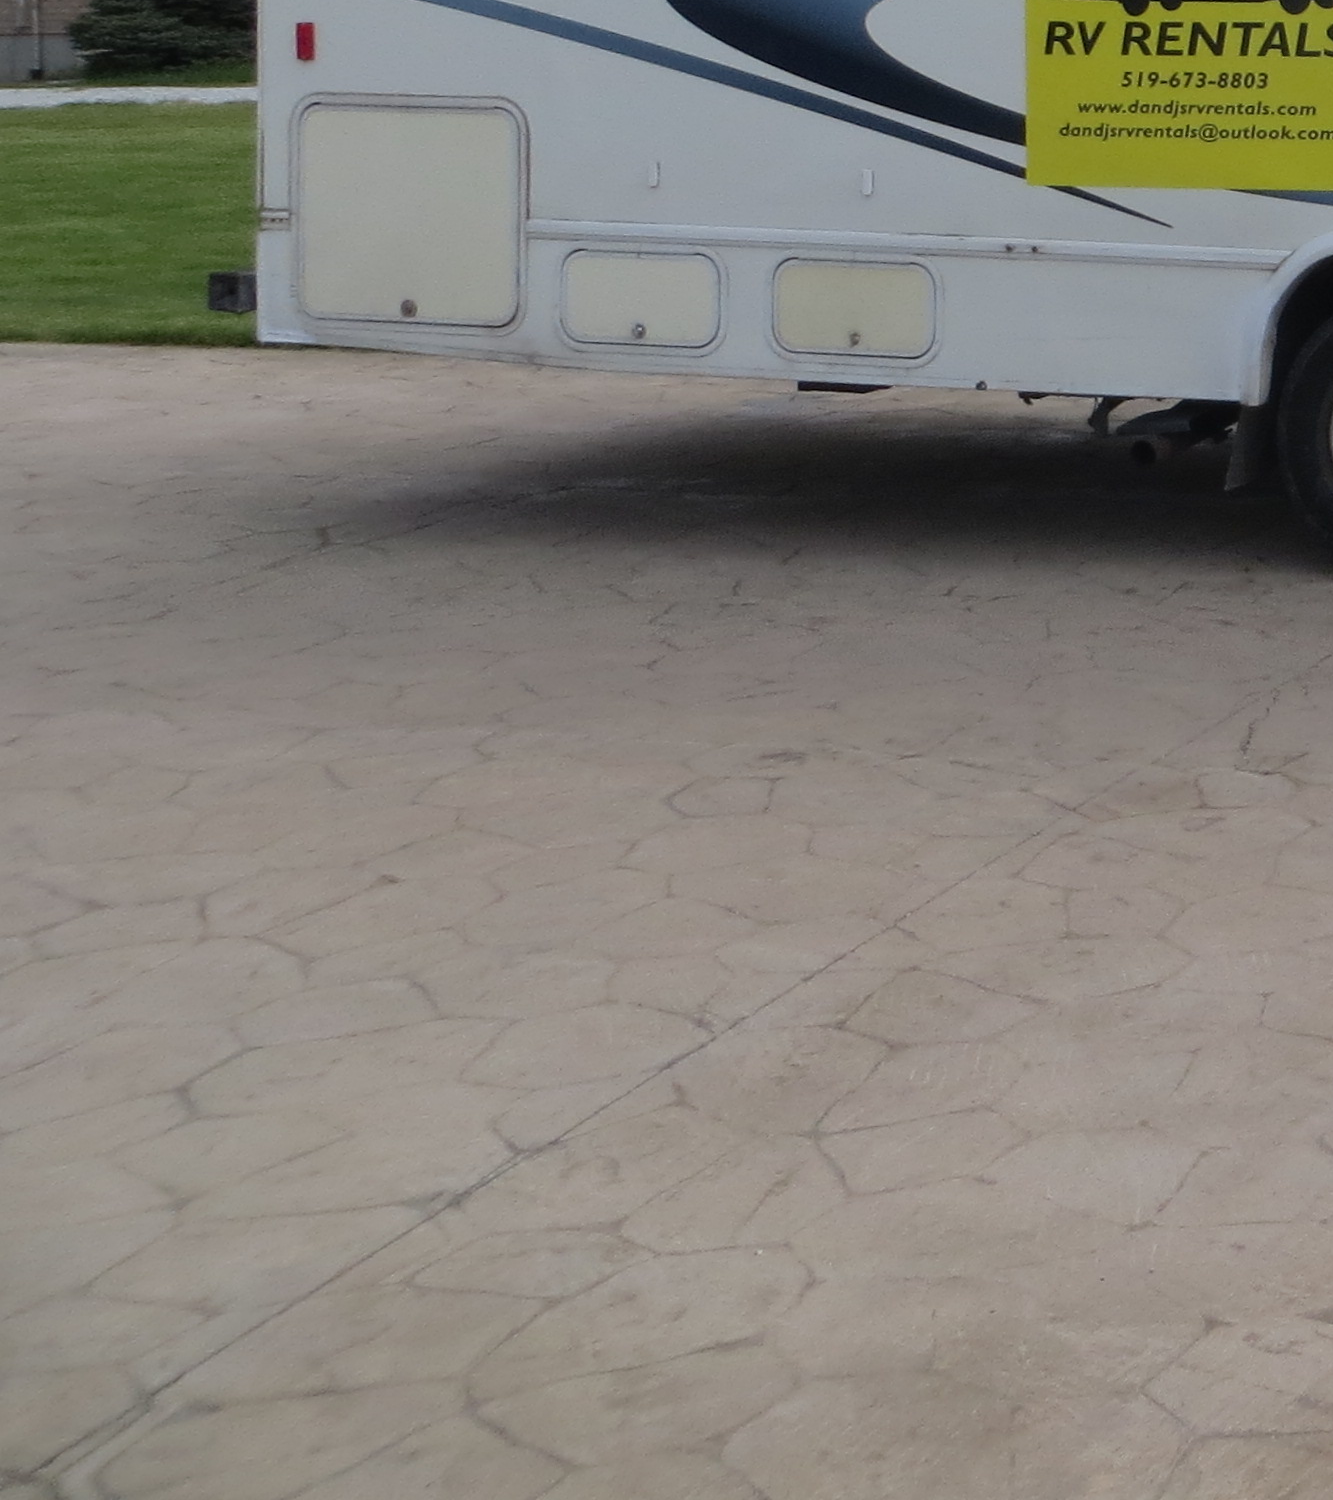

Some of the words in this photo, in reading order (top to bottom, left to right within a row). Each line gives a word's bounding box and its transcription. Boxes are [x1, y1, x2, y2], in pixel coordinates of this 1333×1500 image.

[1044, 20, 1107, 56] RV
[1121, 71, 1269, 89] 519-673-8803
[1077, 100, 1317, 119] www.dandjsrvrentals.com
